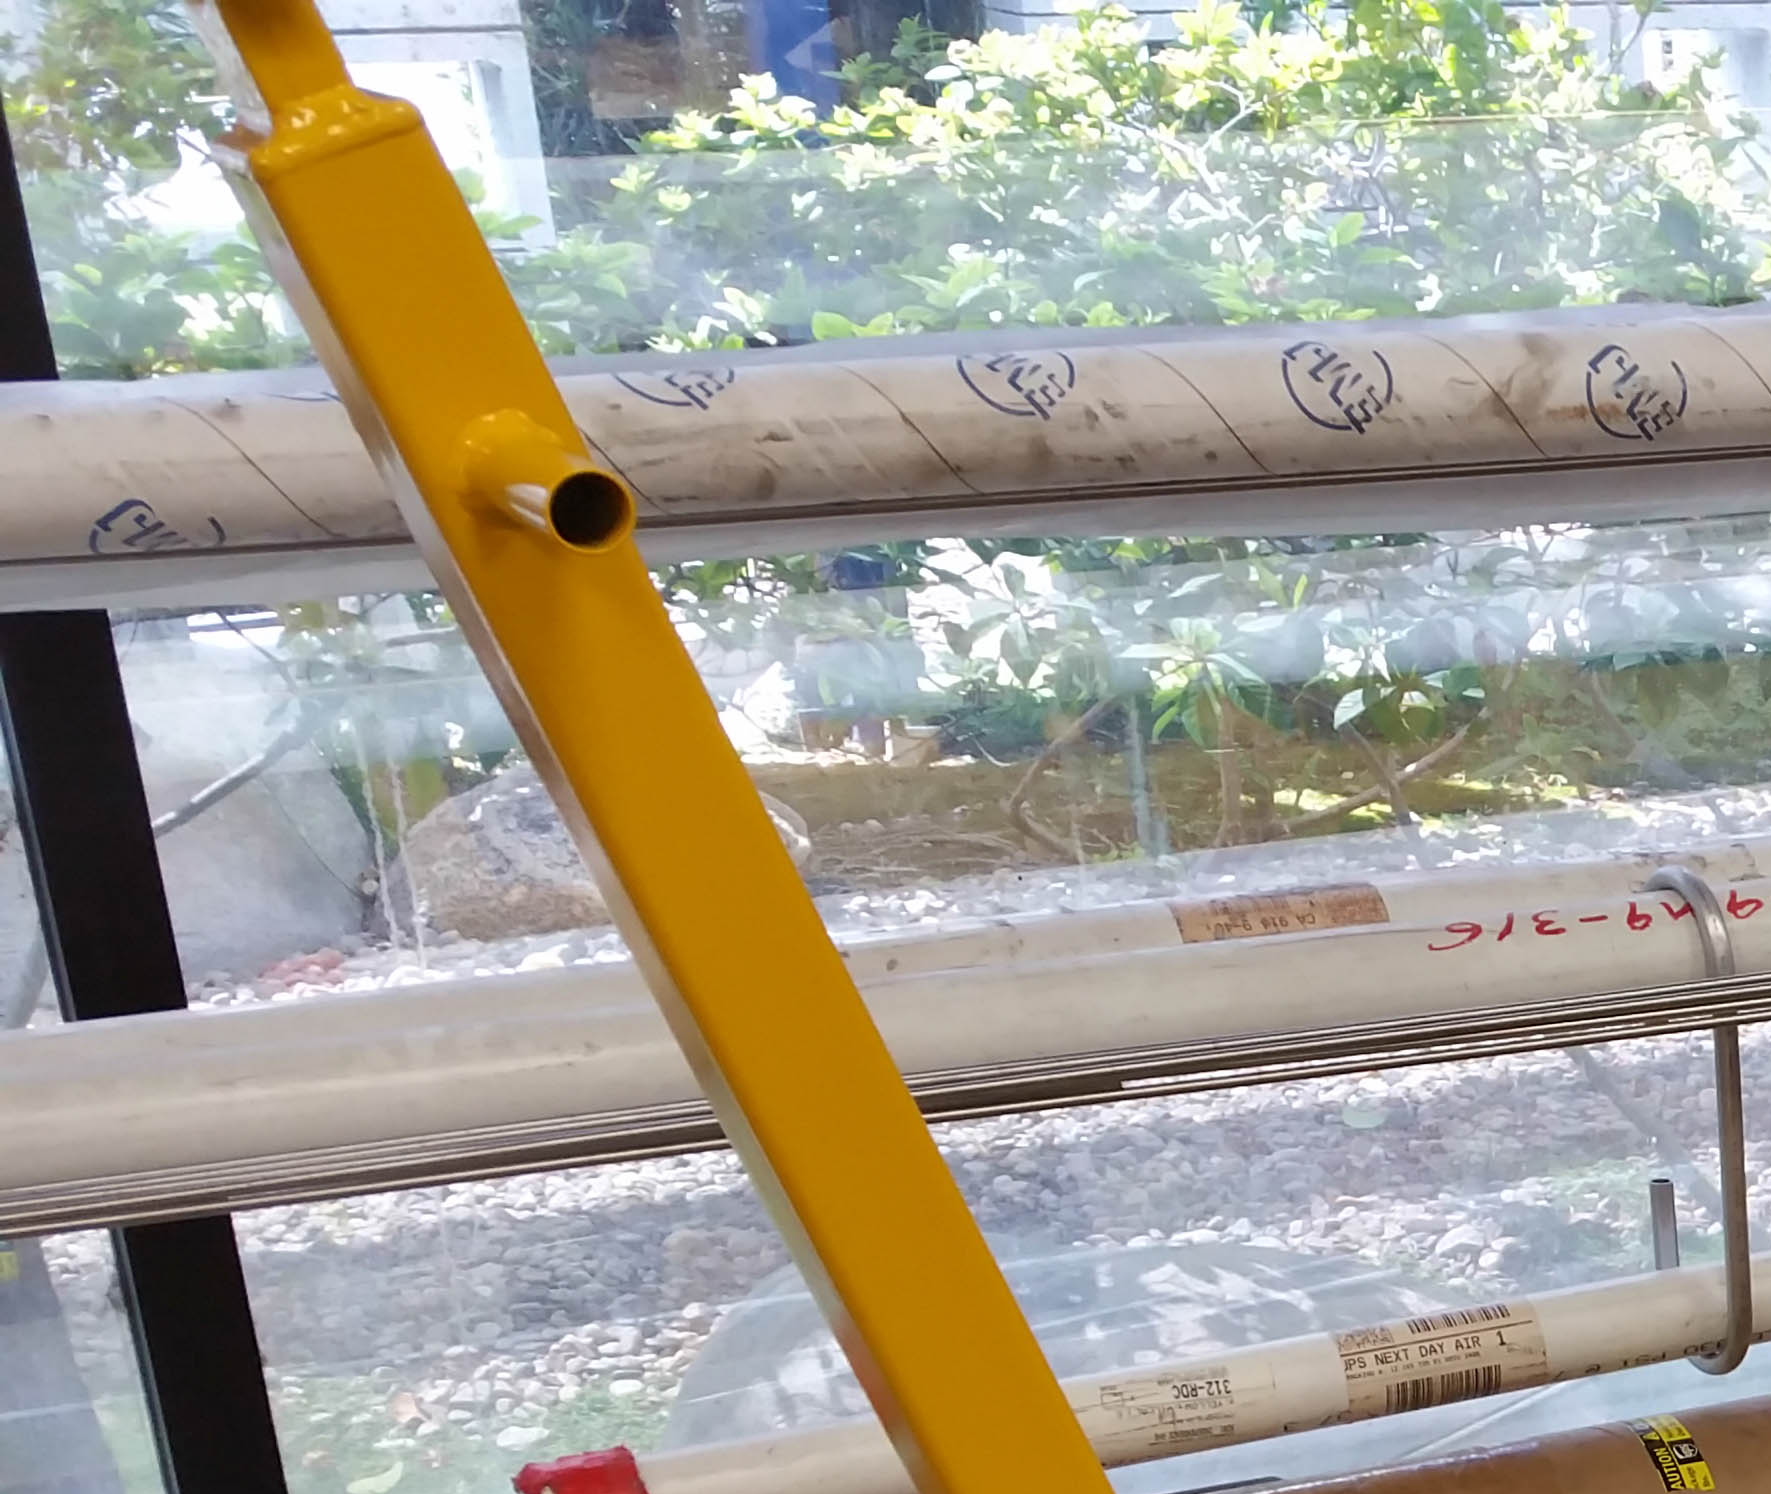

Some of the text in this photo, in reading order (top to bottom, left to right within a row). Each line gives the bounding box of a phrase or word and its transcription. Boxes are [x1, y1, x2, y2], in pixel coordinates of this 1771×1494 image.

[1375, 1349, 1410, 1367] NEXT
[1419, 1344, 1446, 1359] DAY
[1455, 1335, 1481, 1351] AIR
[1496, 1330, 1507, 1347] 1
[1172, 1379, 1232, 1400] 312-RDC
